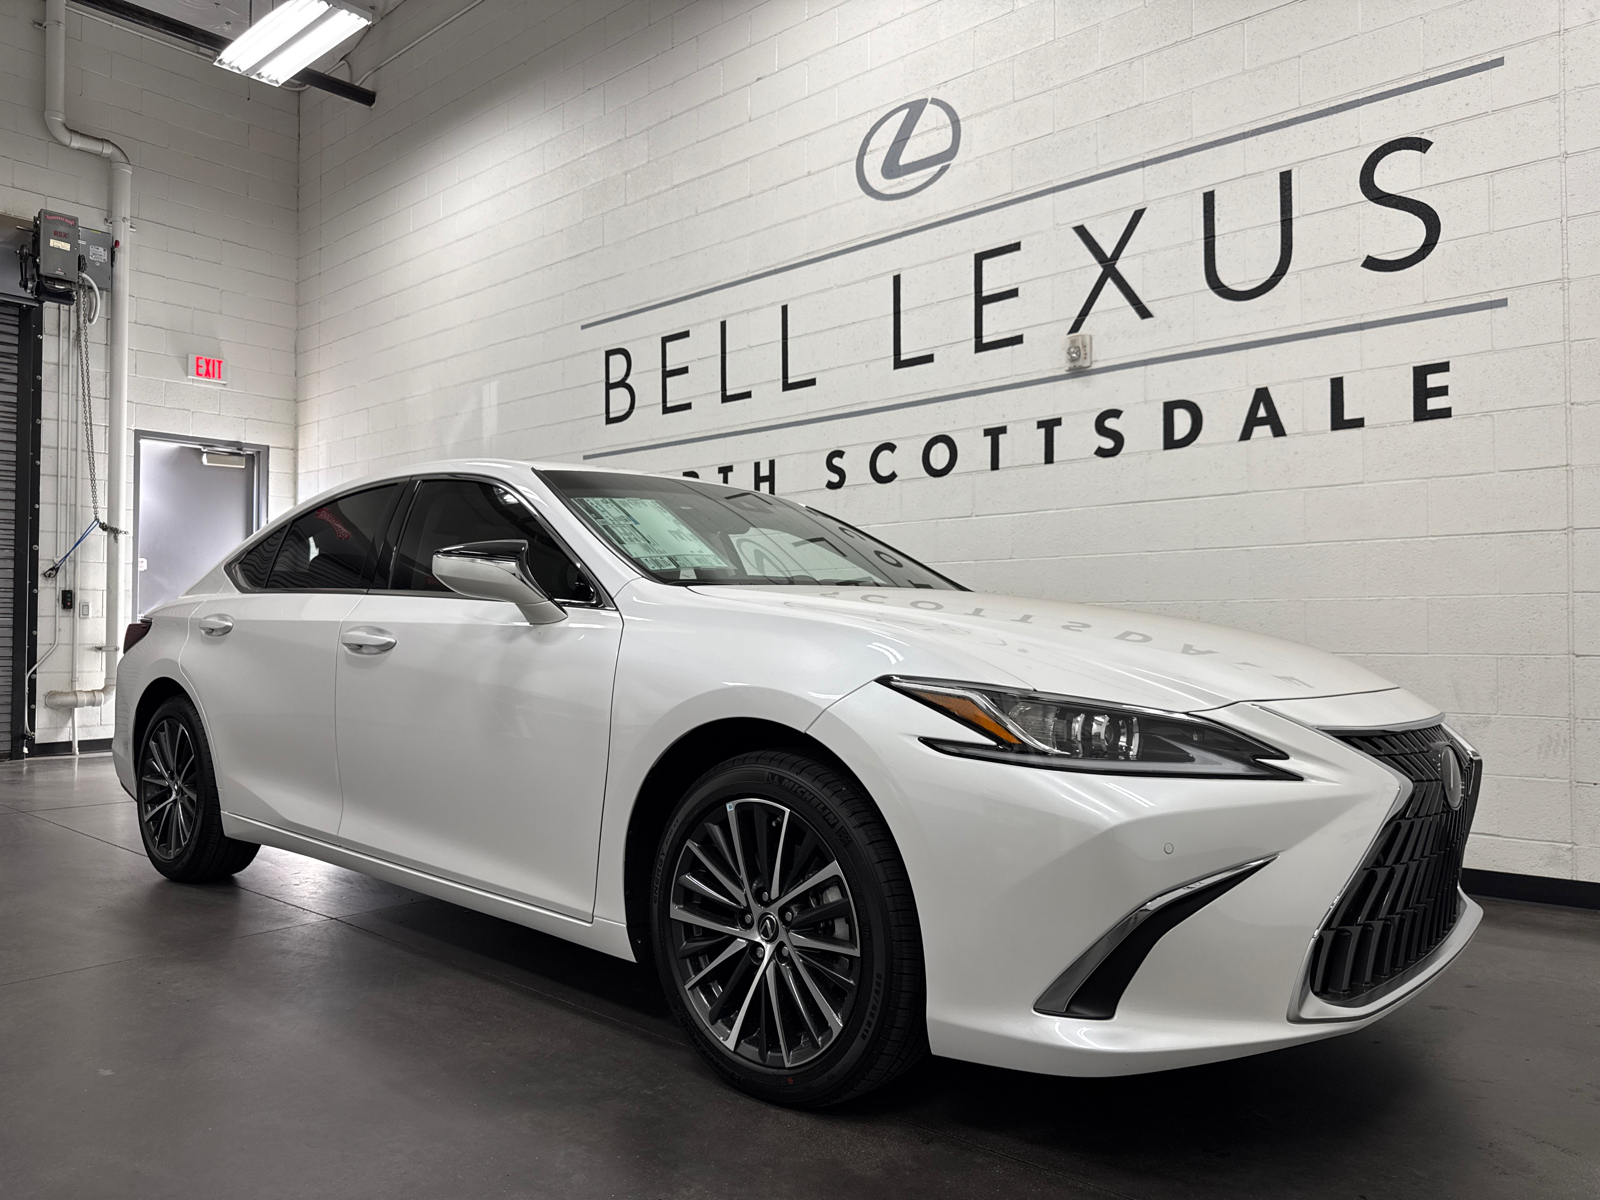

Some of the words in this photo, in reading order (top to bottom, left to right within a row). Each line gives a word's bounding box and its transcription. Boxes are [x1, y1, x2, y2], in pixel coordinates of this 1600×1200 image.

[53, 230, 68, 239] RSX
[604, 304, 817, 426] BELL
[892, 136, 1441, 371] LEXUS
[195, 355, 223, 380] EXIT
[825, 360, 1453, 490] SCOTTSDALE
[780, 777, 840, 830] MICHELIN
